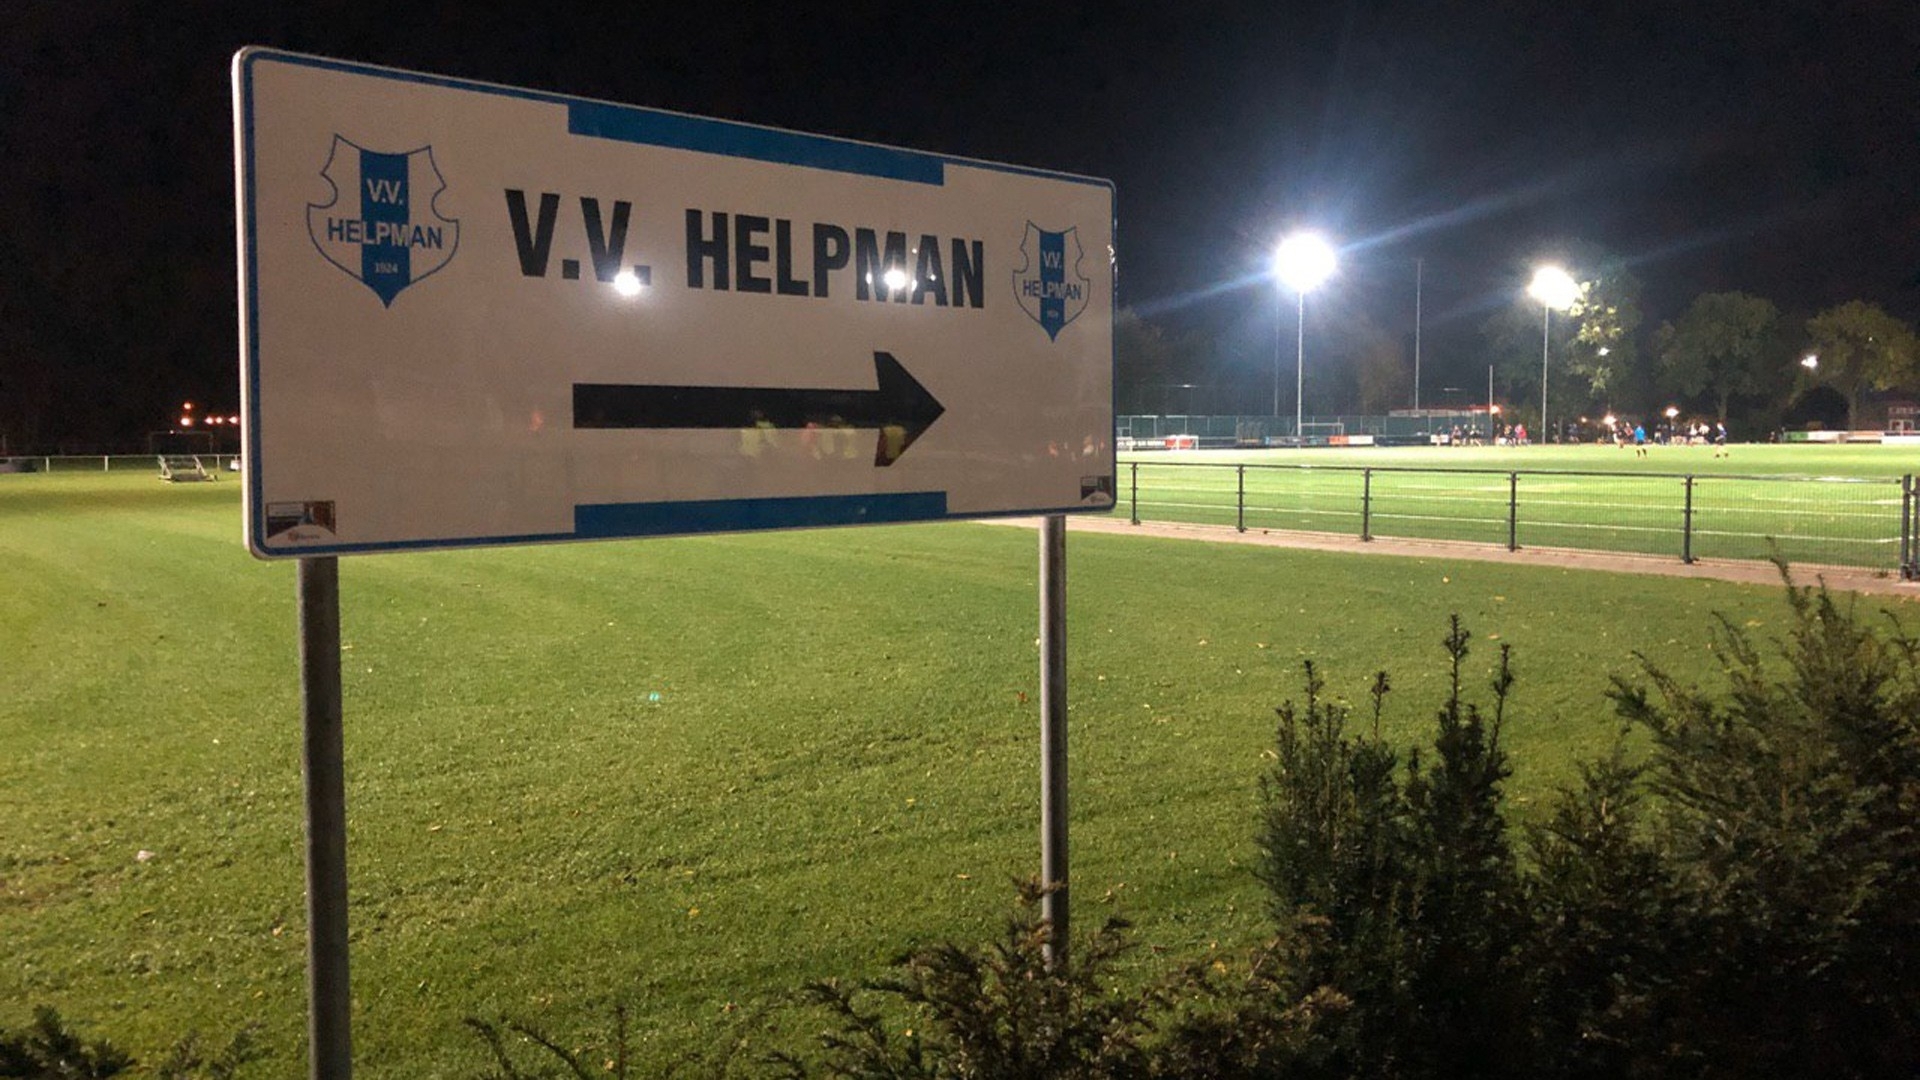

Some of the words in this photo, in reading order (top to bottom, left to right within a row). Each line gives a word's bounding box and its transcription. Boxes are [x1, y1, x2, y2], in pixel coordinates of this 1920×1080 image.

[366, 178, 404, 205] V.V.
[327, 217, 443, 250] HELPMAN
[504, 188, 652, 286] V.V.
[685, 208, 985, 309] HELPMAN
[1022, 279, 1082, 301] HELPMAN
